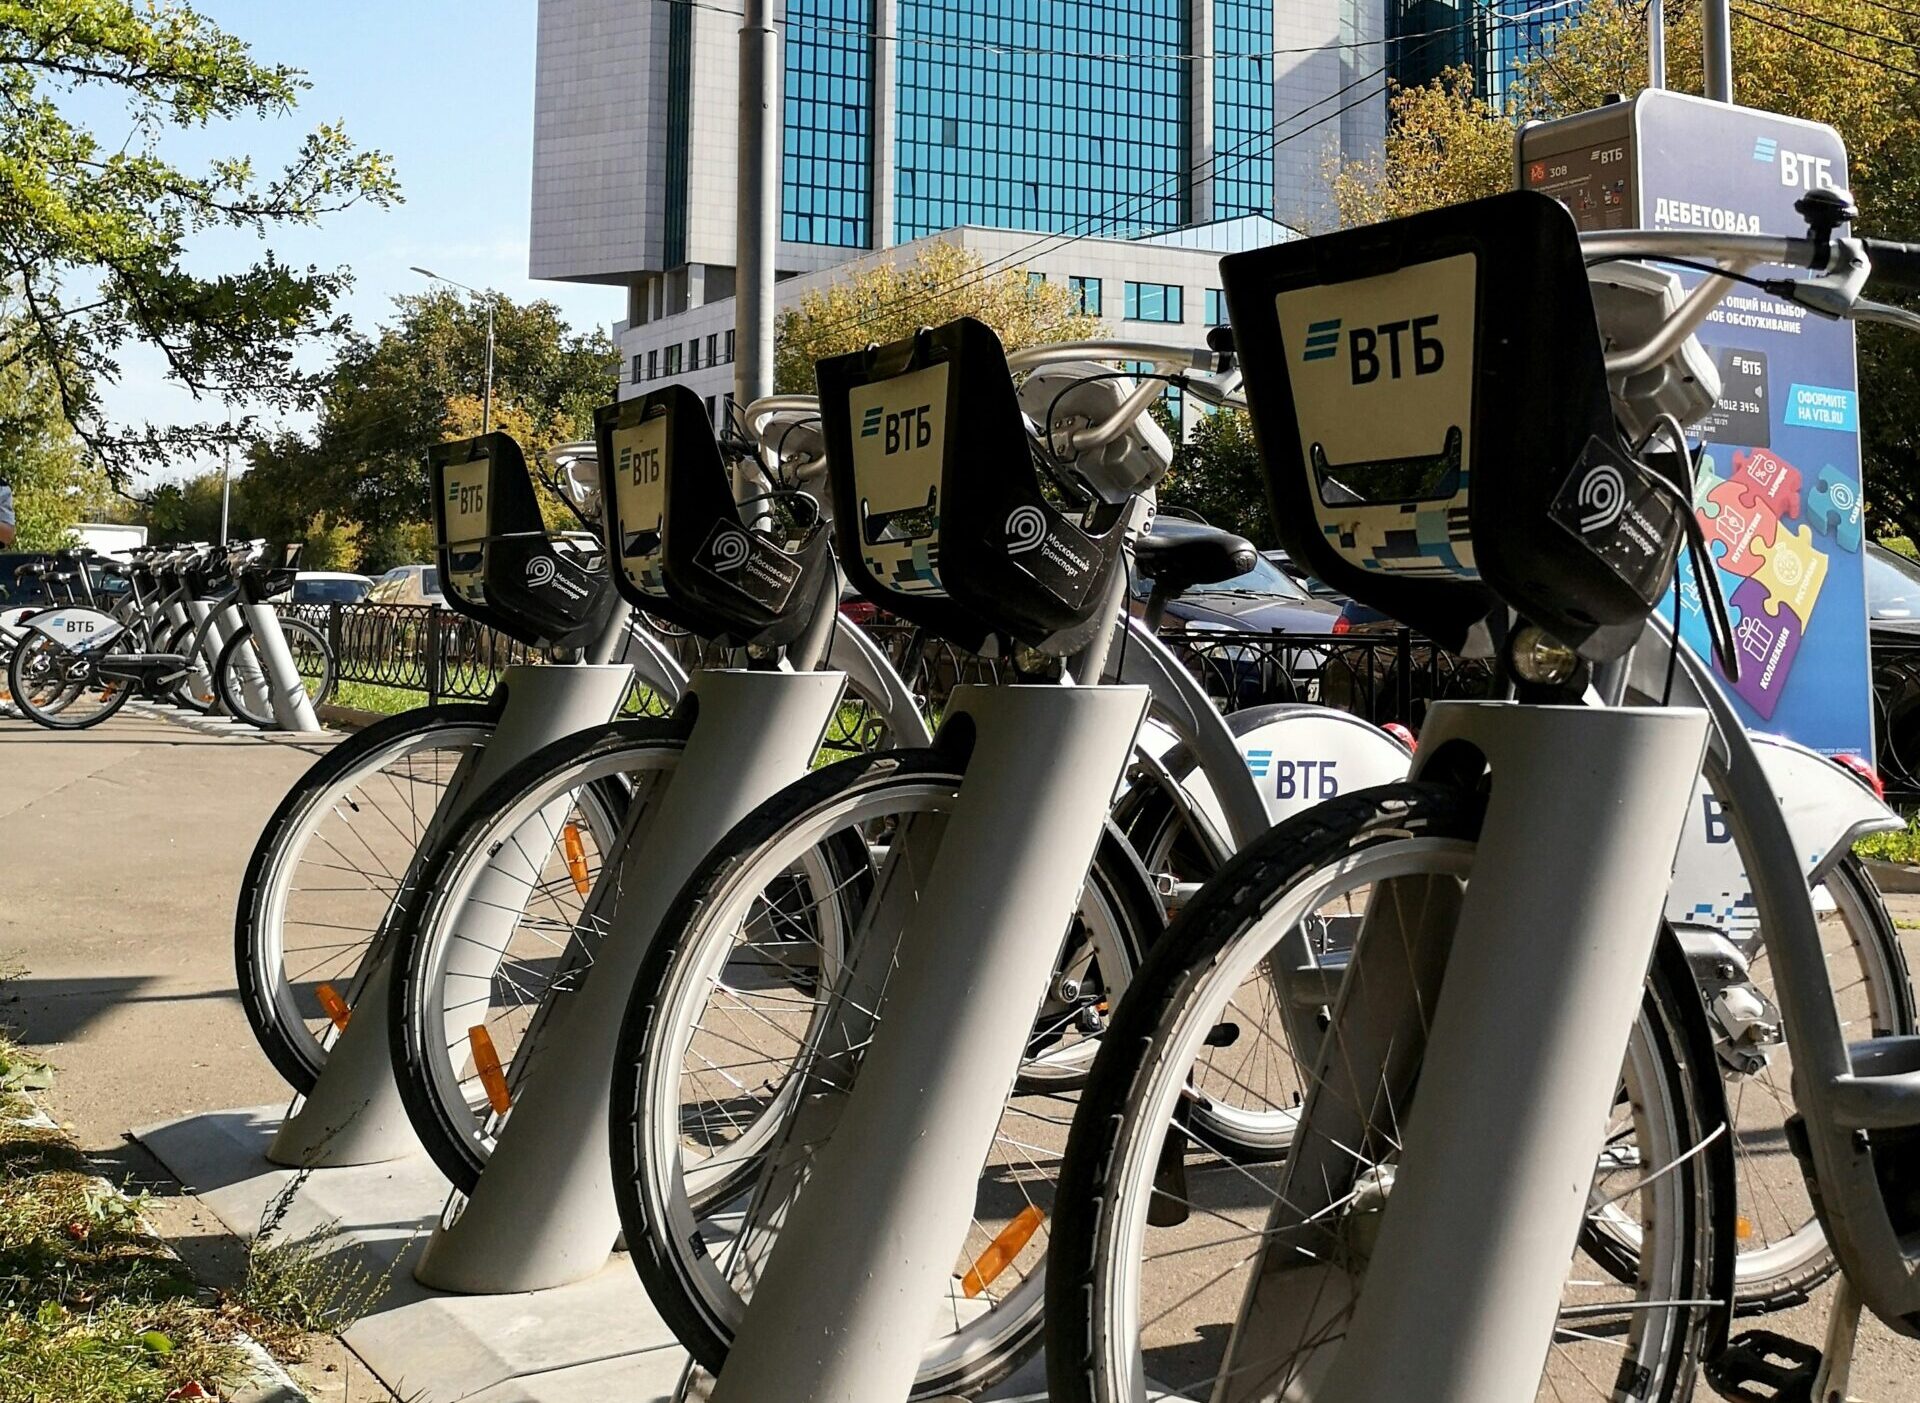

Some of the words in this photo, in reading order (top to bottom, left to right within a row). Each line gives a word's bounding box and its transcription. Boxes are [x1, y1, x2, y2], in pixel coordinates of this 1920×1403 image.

[1601, 148, 1622, 164] ВТБ
[1780, 150, 1833, 190] ВТБ
[1654, 198, 1760, 234] ДЕБЕТОВАЯ
[1726, 296, 1758, 311] ОПЦИЙ
[1760, 299, 1773, 313] НА
[1775, 302, 1807, 319] ВЫБОР
[1726, 312, 1801, 334] ОБСЛУЖИВАНИЕ
[1349, 314, 1444, 385] ВТБ
[1741, 360, 1761, 375] ВТБ
[1718, 398, 1738, 411] 9012
[1740, 401, 1759, 413] 3456
[1797, 390, 1847, 409] ОФОРМИТЕ
[1798, 406, 1812, 421] НА
[1812, 408, 1843, 424] VTB.RU
[885, 404, 931, 455] ВТБ
[633, 448, 659, 486] ВТБ
[460, 485, 483, 514] ВТБ
[1040, 542, 1079, 578] Транспорт
[1046, 533, 1090, 573] Московский
[745, 561, 782, 589] Транспорт
[750, 551, 792, 584] Московский
[551, 579, 580, 601] Транспорт
[555, 572, 589, 598] Московский
[66, 621, 95, 633] ВТБ
[1760, 627, 1790, 690] КОЛЛЕКЦИЯ
[1276, 760, 1339, 800] ВТБ
